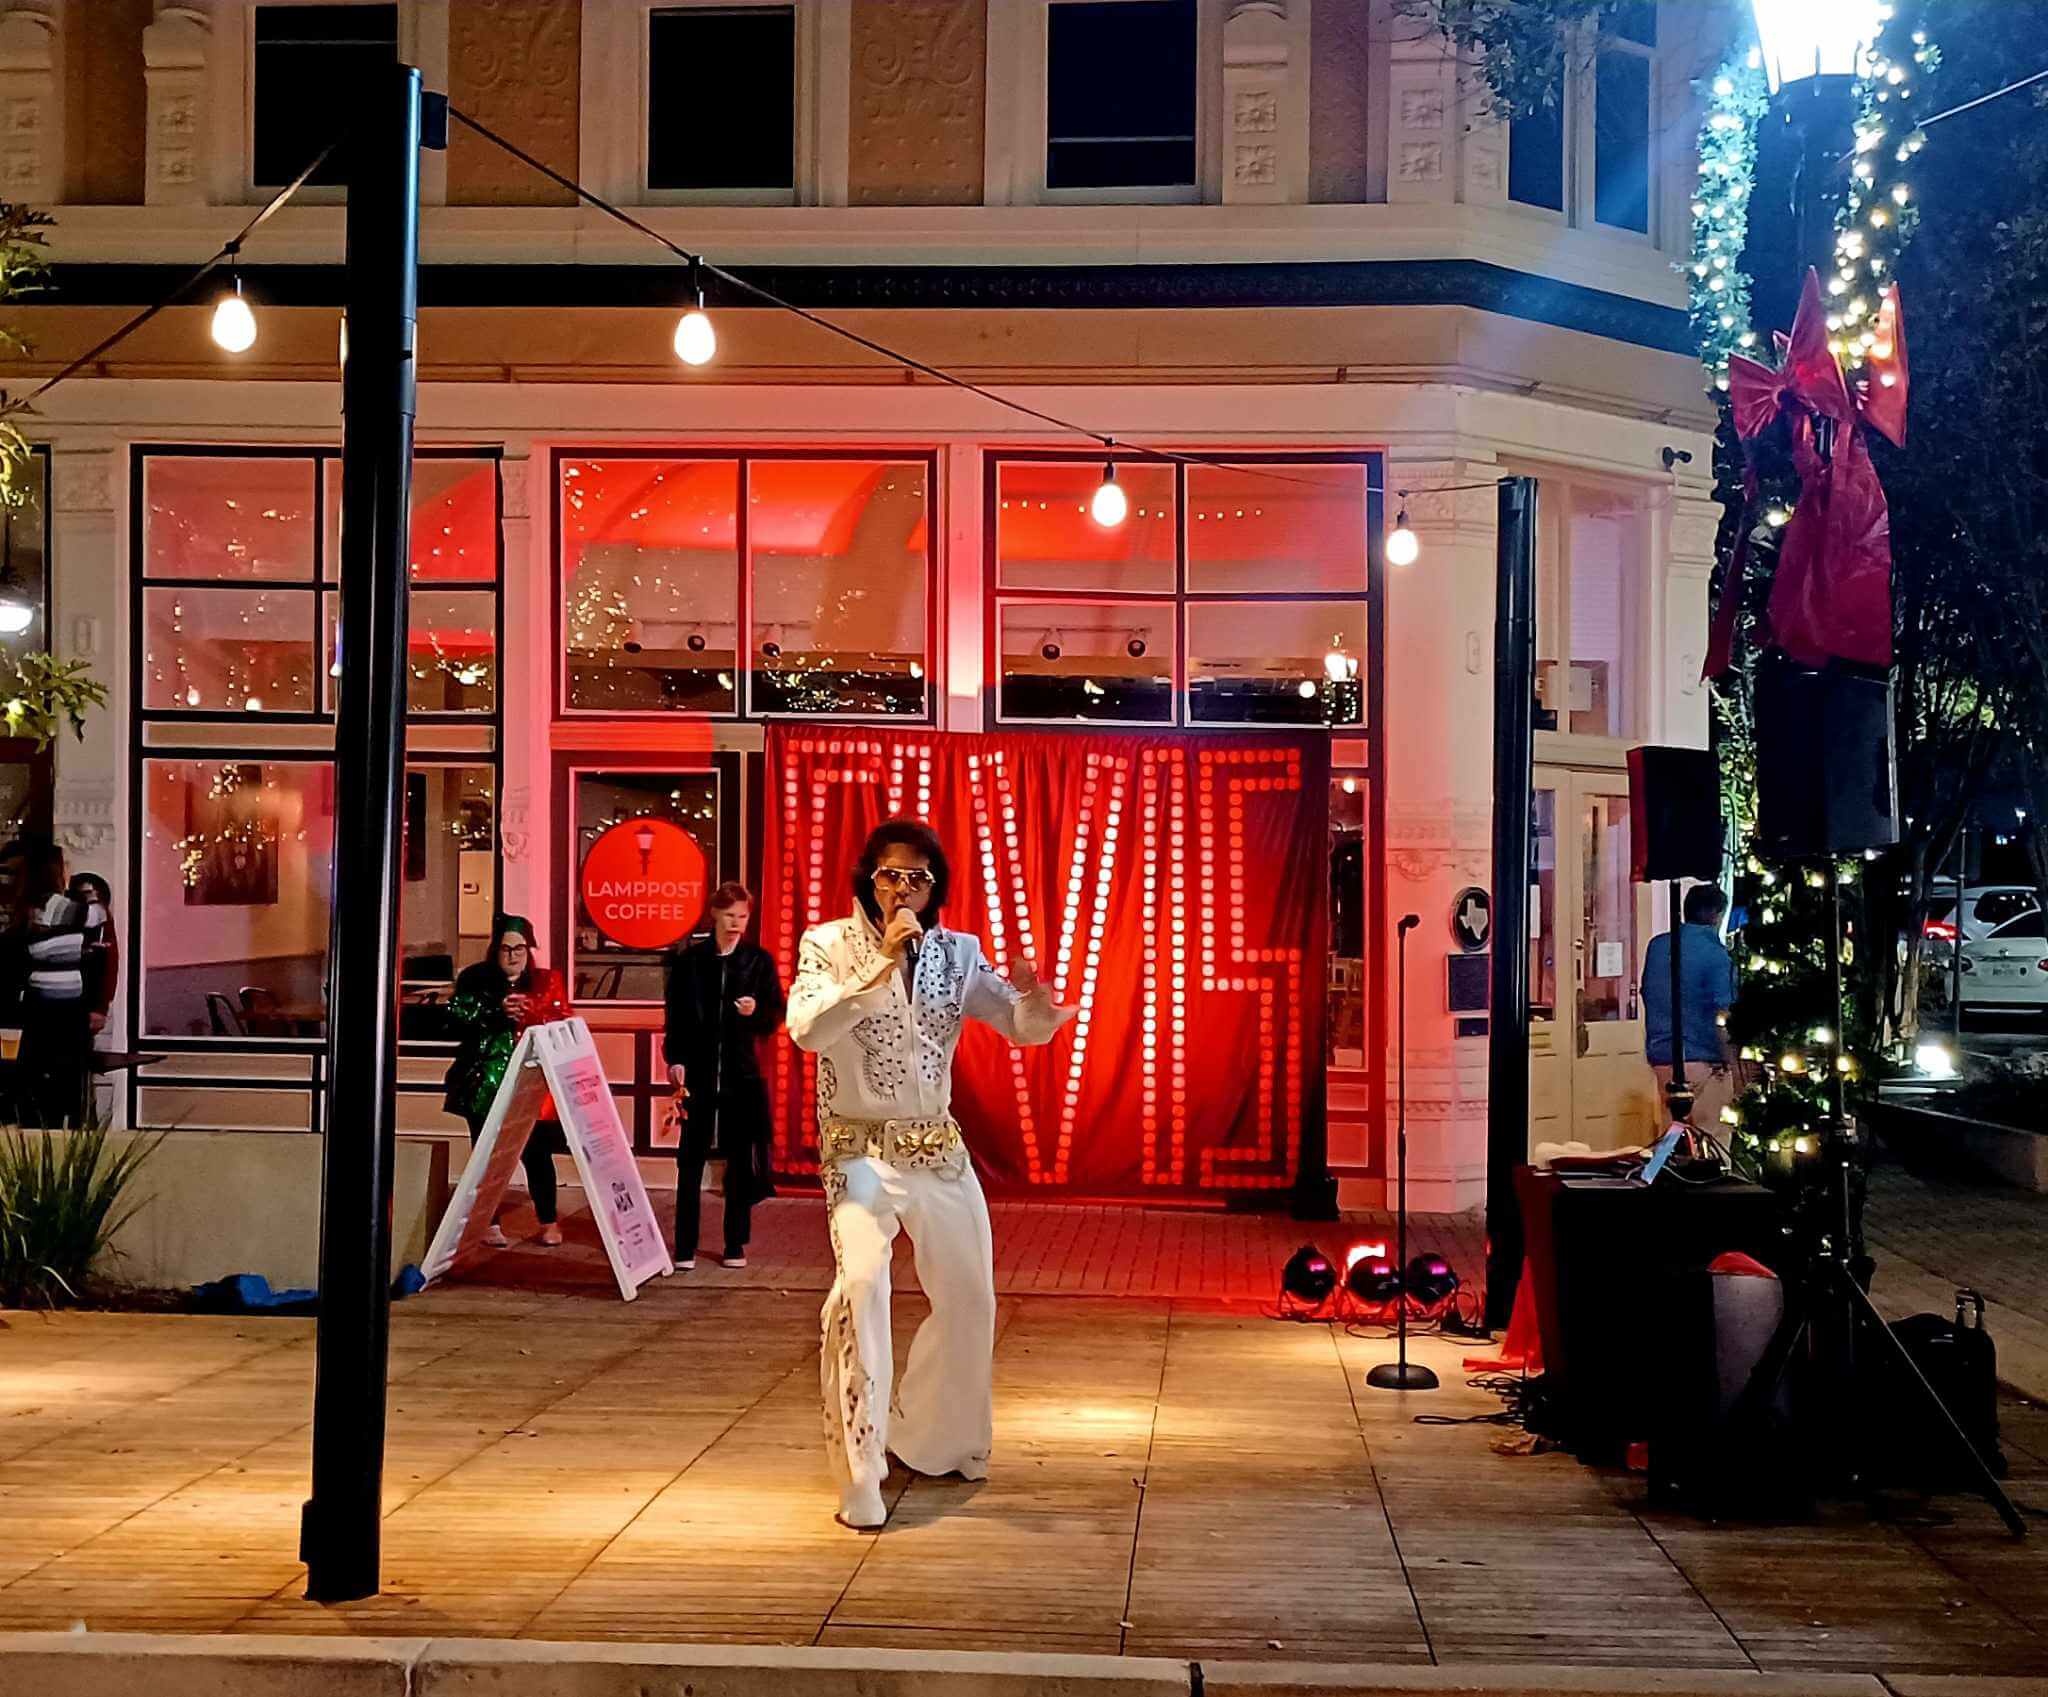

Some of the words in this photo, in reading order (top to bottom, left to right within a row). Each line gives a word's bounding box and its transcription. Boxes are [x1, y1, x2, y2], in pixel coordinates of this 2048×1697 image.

[588, 881, 701, 898] LAMPPOST
[605, 903, 684, 920] COFFEE
[771, 740, 1301, 1187] EVIS
